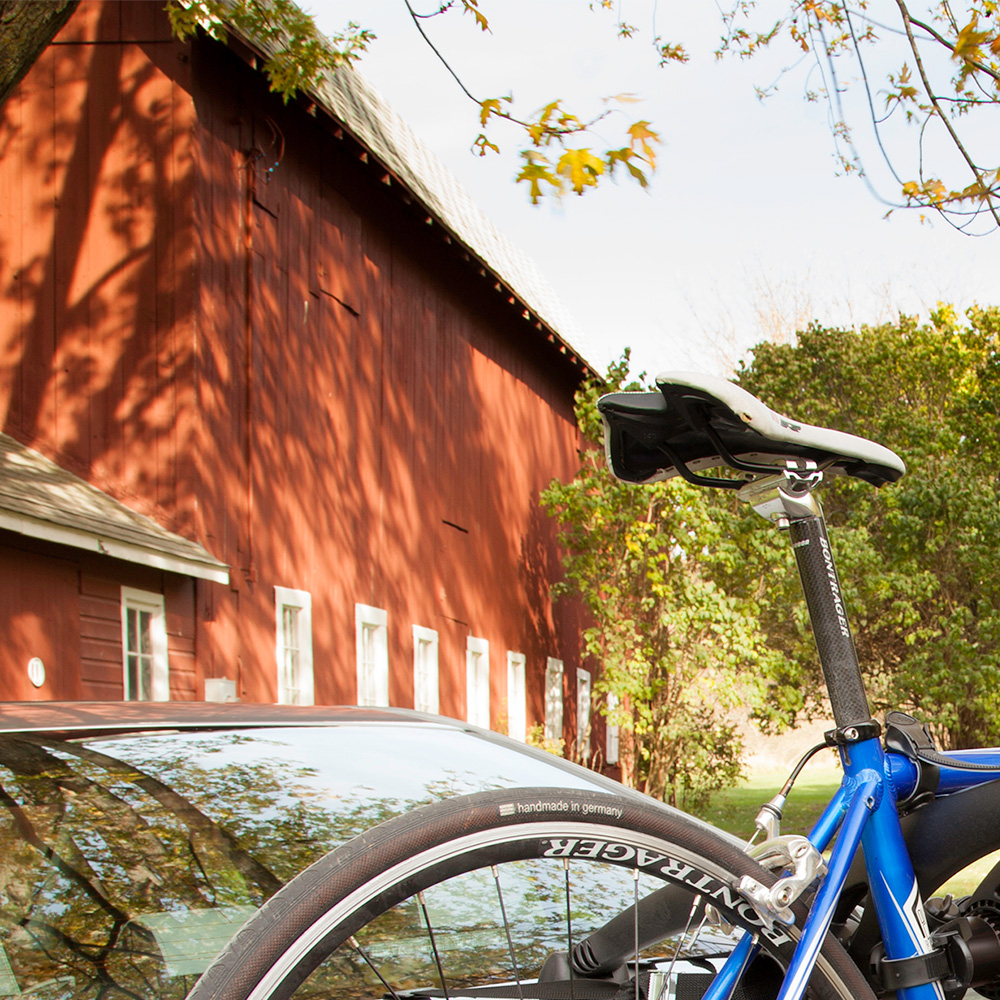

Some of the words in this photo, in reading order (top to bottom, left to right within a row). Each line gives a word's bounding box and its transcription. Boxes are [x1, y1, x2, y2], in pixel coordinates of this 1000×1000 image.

[818, 536, 850, 638] BONTRAGER
[517, 801, 569, 813] handmade
[570, 801, 580, 812] in
[582, 803, 623, 819] germany
[545, 839, 793, 949] BONTRAGER
